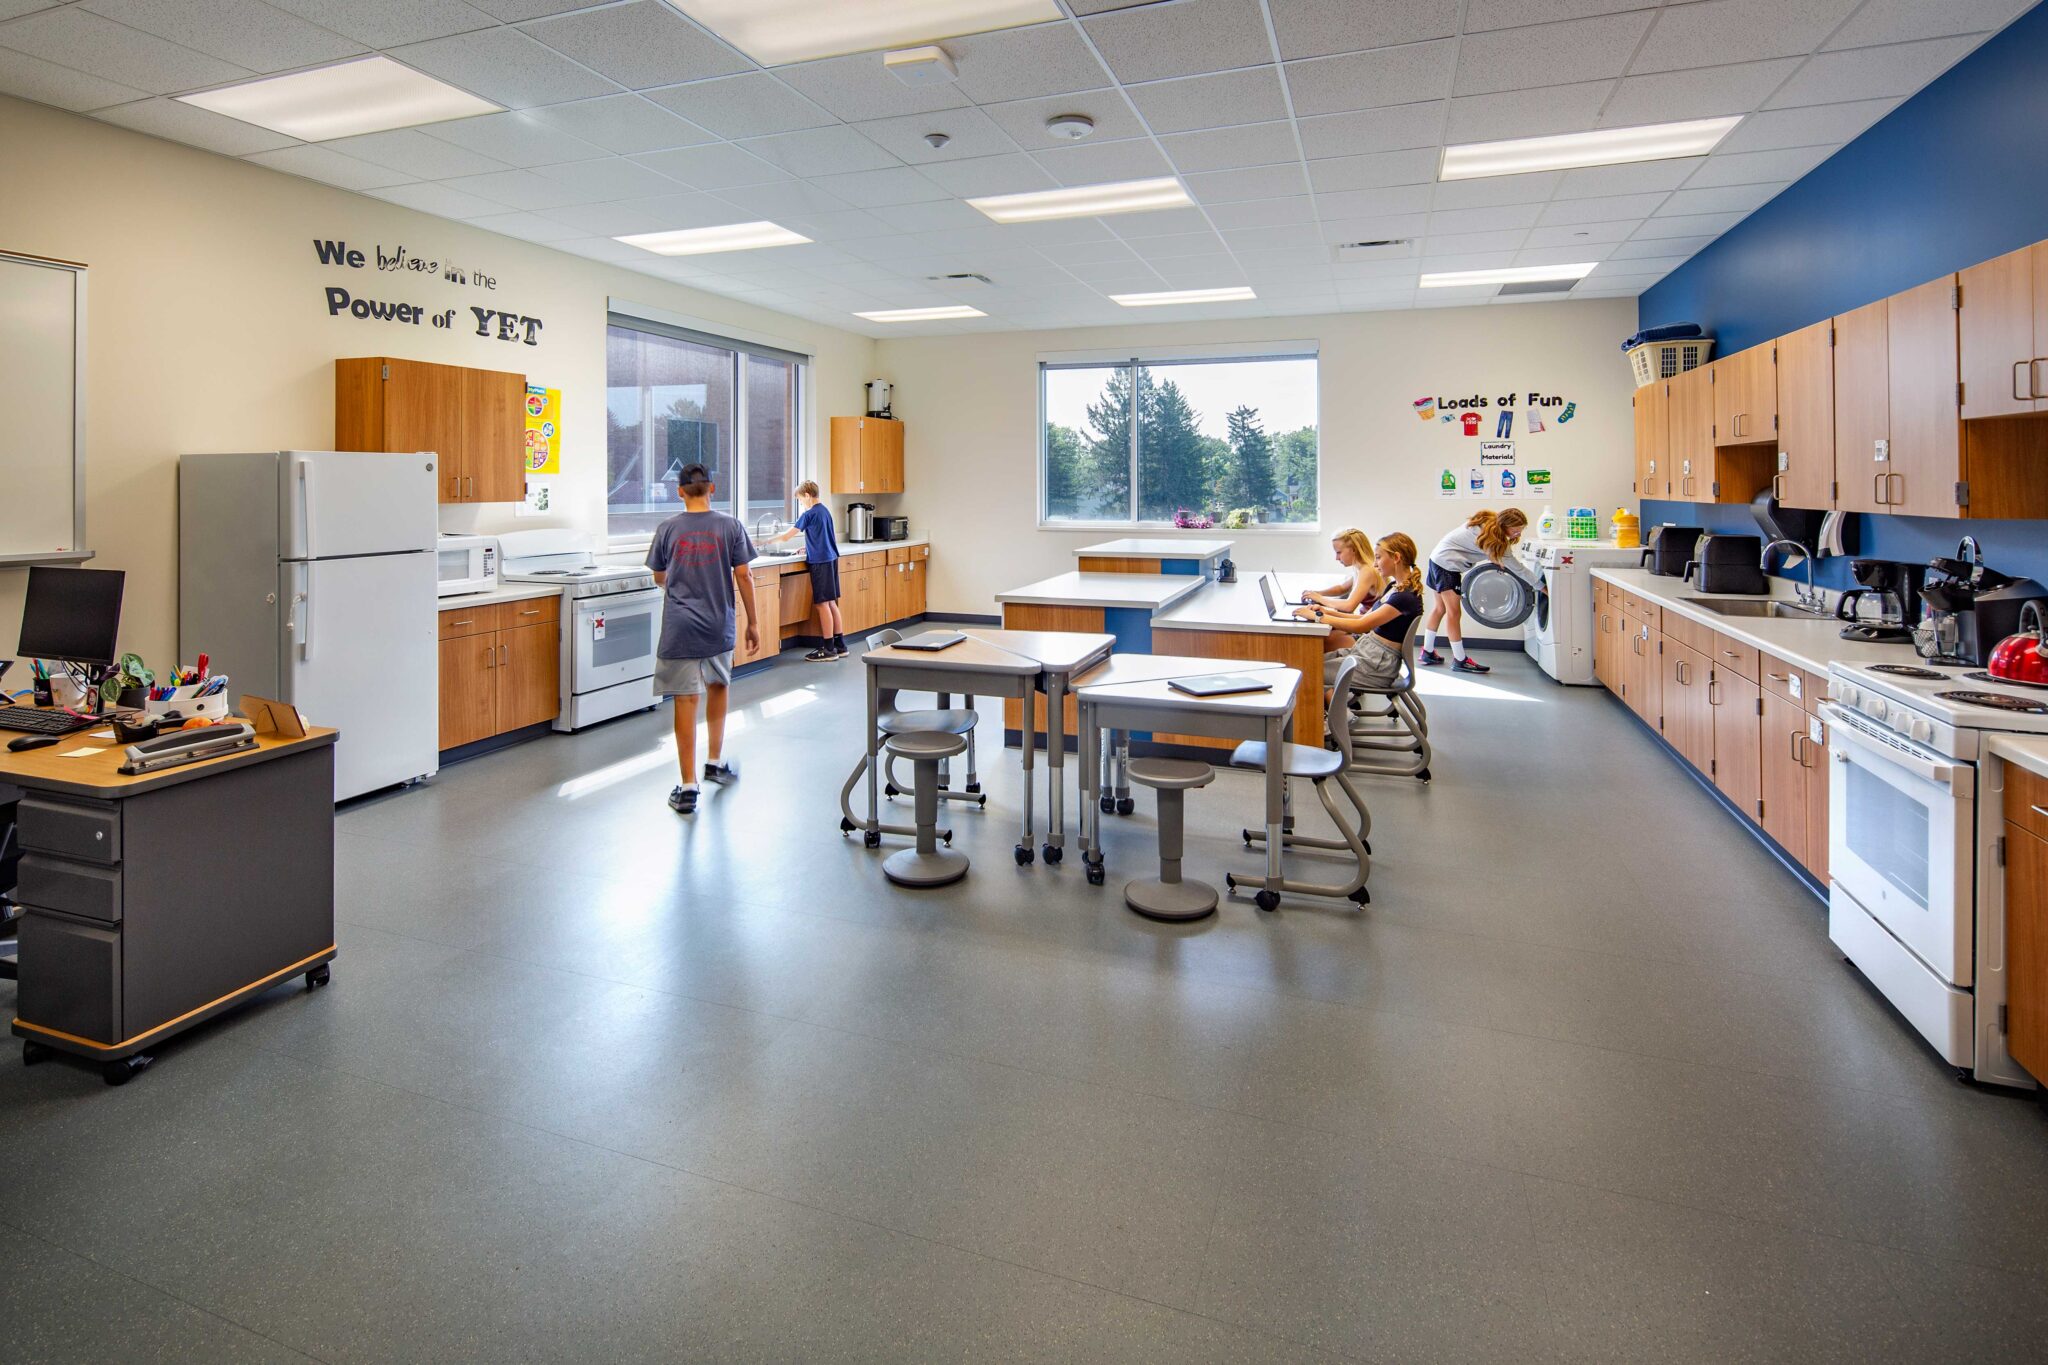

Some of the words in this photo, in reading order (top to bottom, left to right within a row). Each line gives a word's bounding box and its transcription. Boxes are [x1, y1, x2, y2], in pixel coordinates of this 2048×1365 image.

[313, 239, 365, 268] We
[376, 244, 438, 273] believe
[473, 269, 497, 290] the
[325, 287, 424, 325] Power
[432, 309, 456, 329] of
[470, 306, 543, 346] YET
[1438, 394, 1488, 409] Loads
[1497, 393, 1516, 407] of
[1528, 393, 1563, 407] Fun
